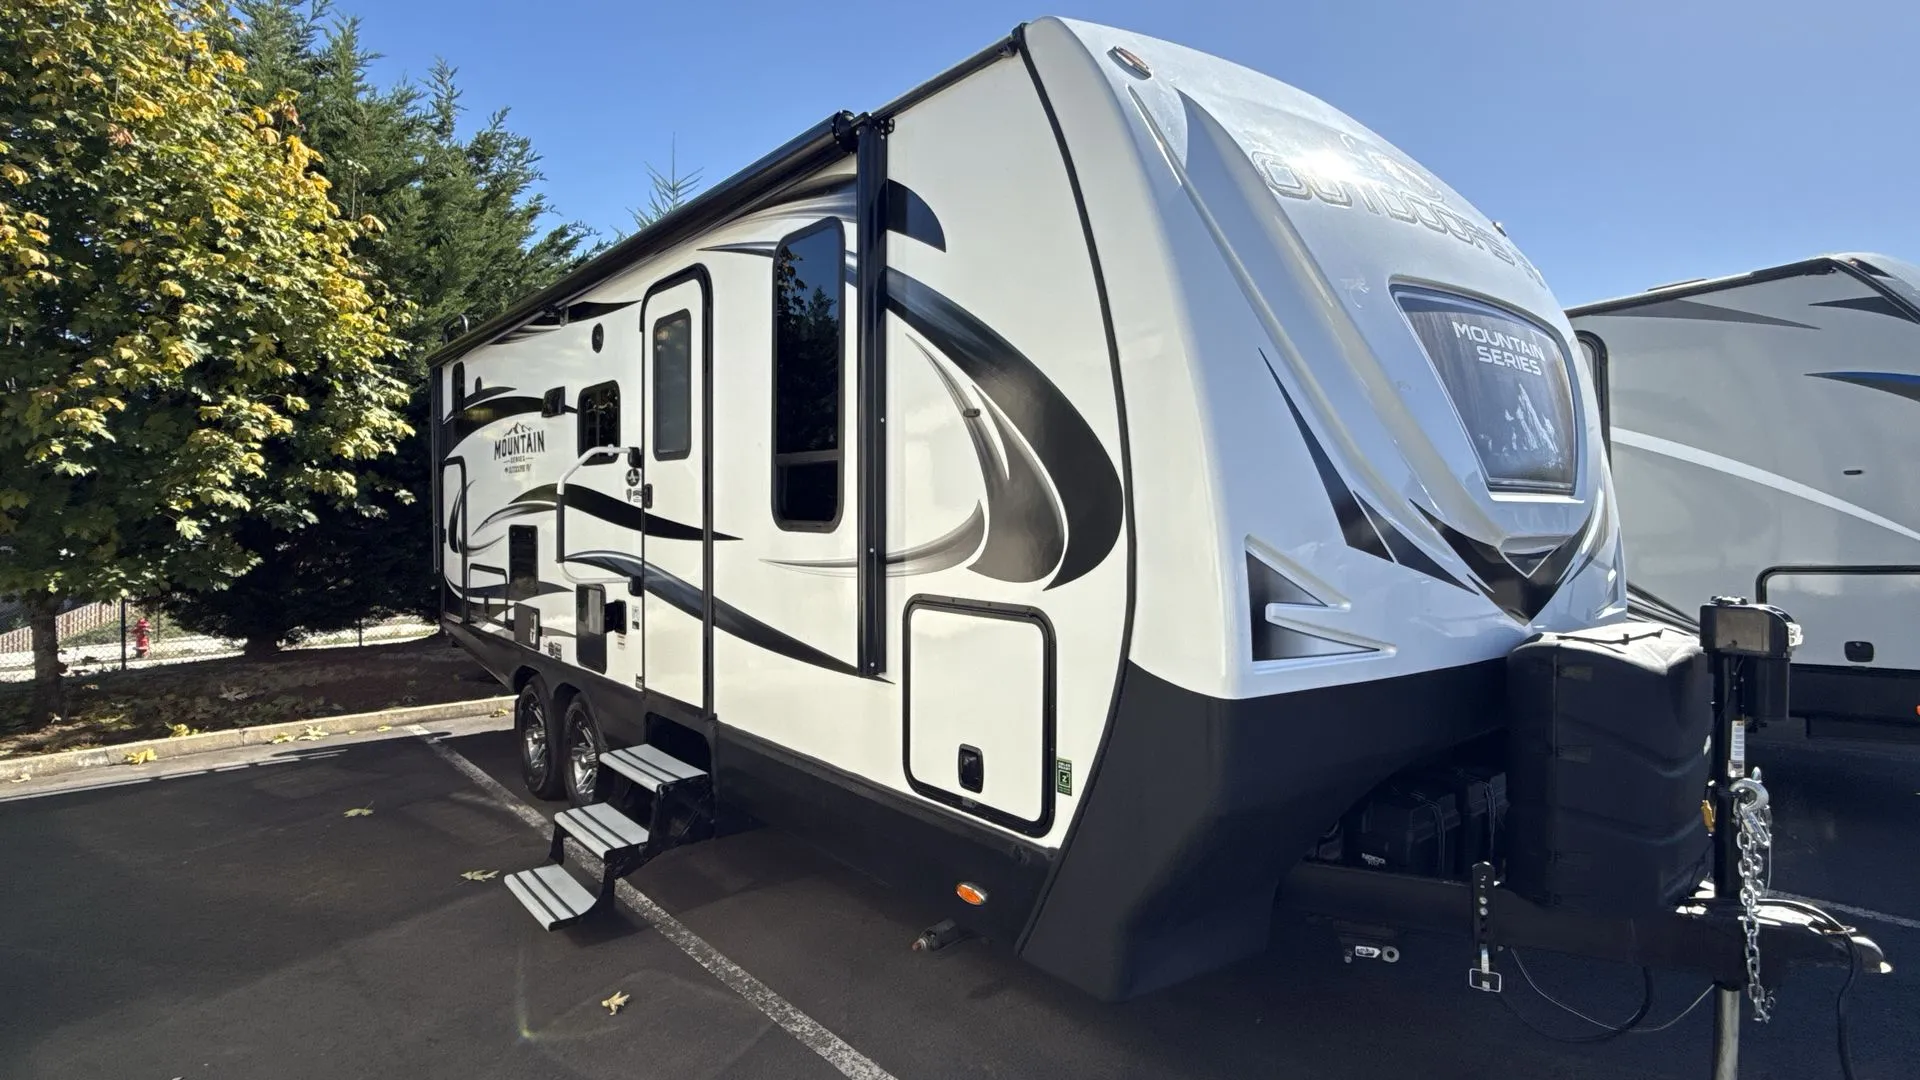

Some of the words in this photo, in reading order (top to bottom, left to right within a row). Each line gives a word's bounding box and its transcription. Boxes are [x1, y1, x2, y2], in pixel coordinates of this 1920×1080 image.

[1452, 321, 1546, 362] MOUNTAIN
[1476, 346, 1542, 376] SERIES
[494, 430, 546, 461] MOUNTAIN
